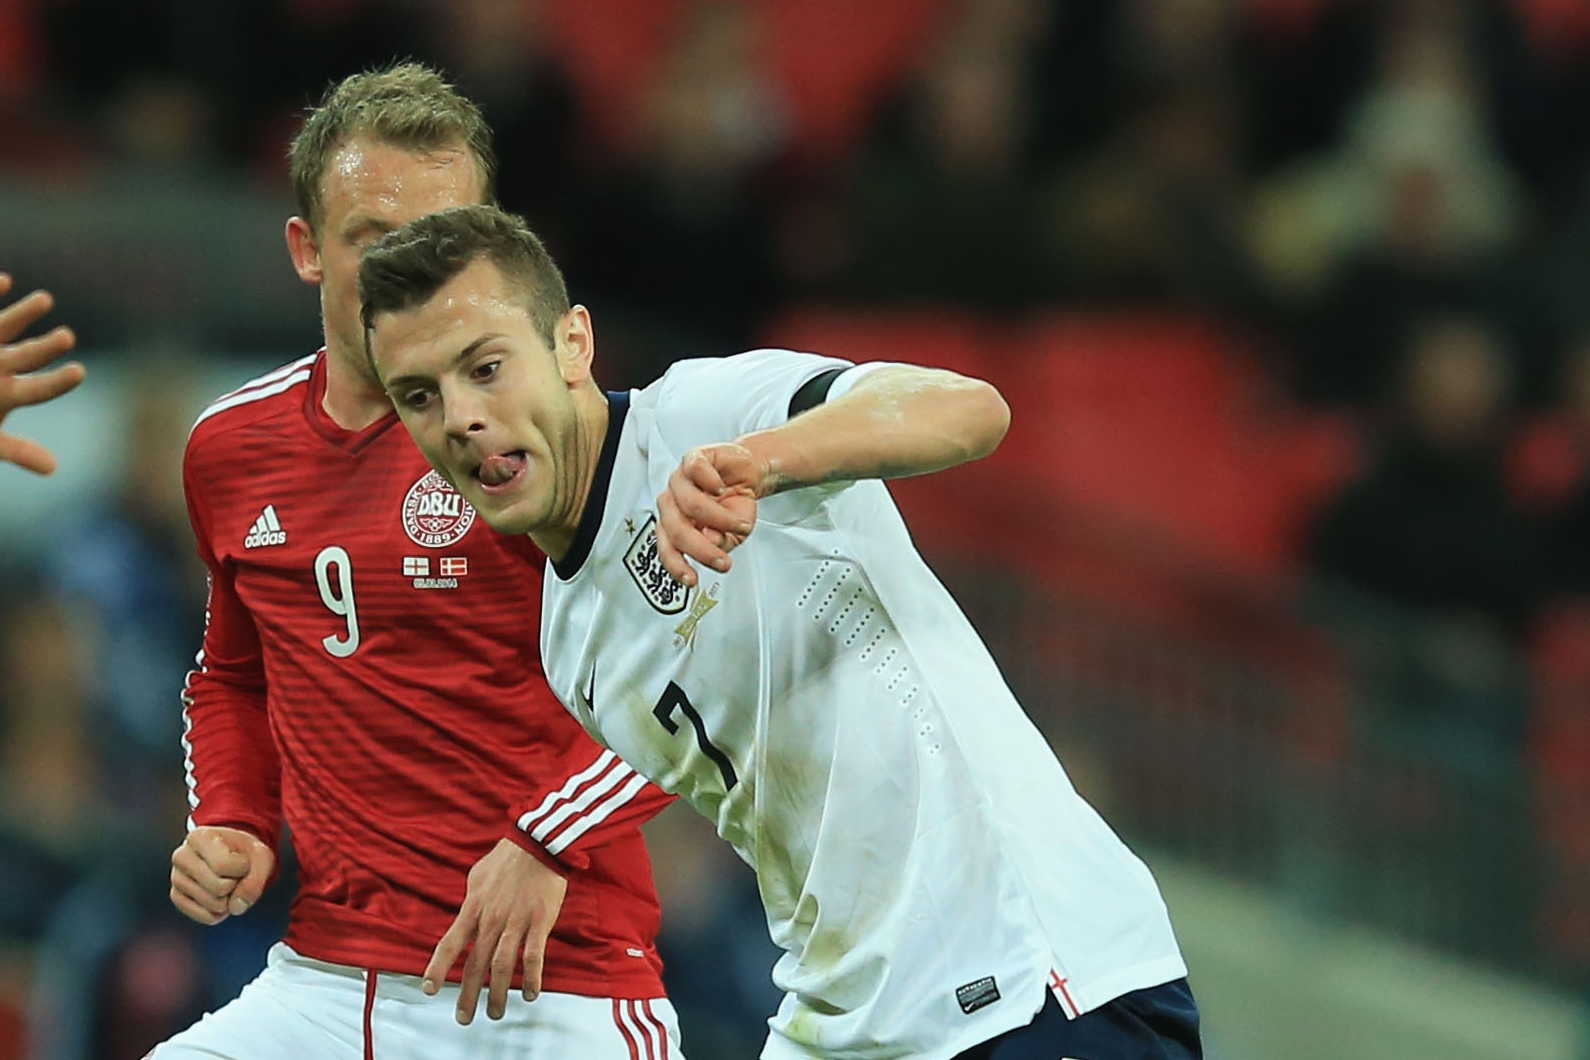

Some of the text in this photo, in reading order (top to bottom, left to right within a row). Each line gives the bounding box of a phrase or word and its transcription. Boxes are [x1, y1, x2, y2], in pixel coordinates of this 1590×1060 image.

[417, 491, 461, 516] DBU
[244, 529, 287, 549] adidas
[419, 532, 451, 544] 1889
[314, 546, 360, 658] 9
[652, 680, 739, 792] 7
